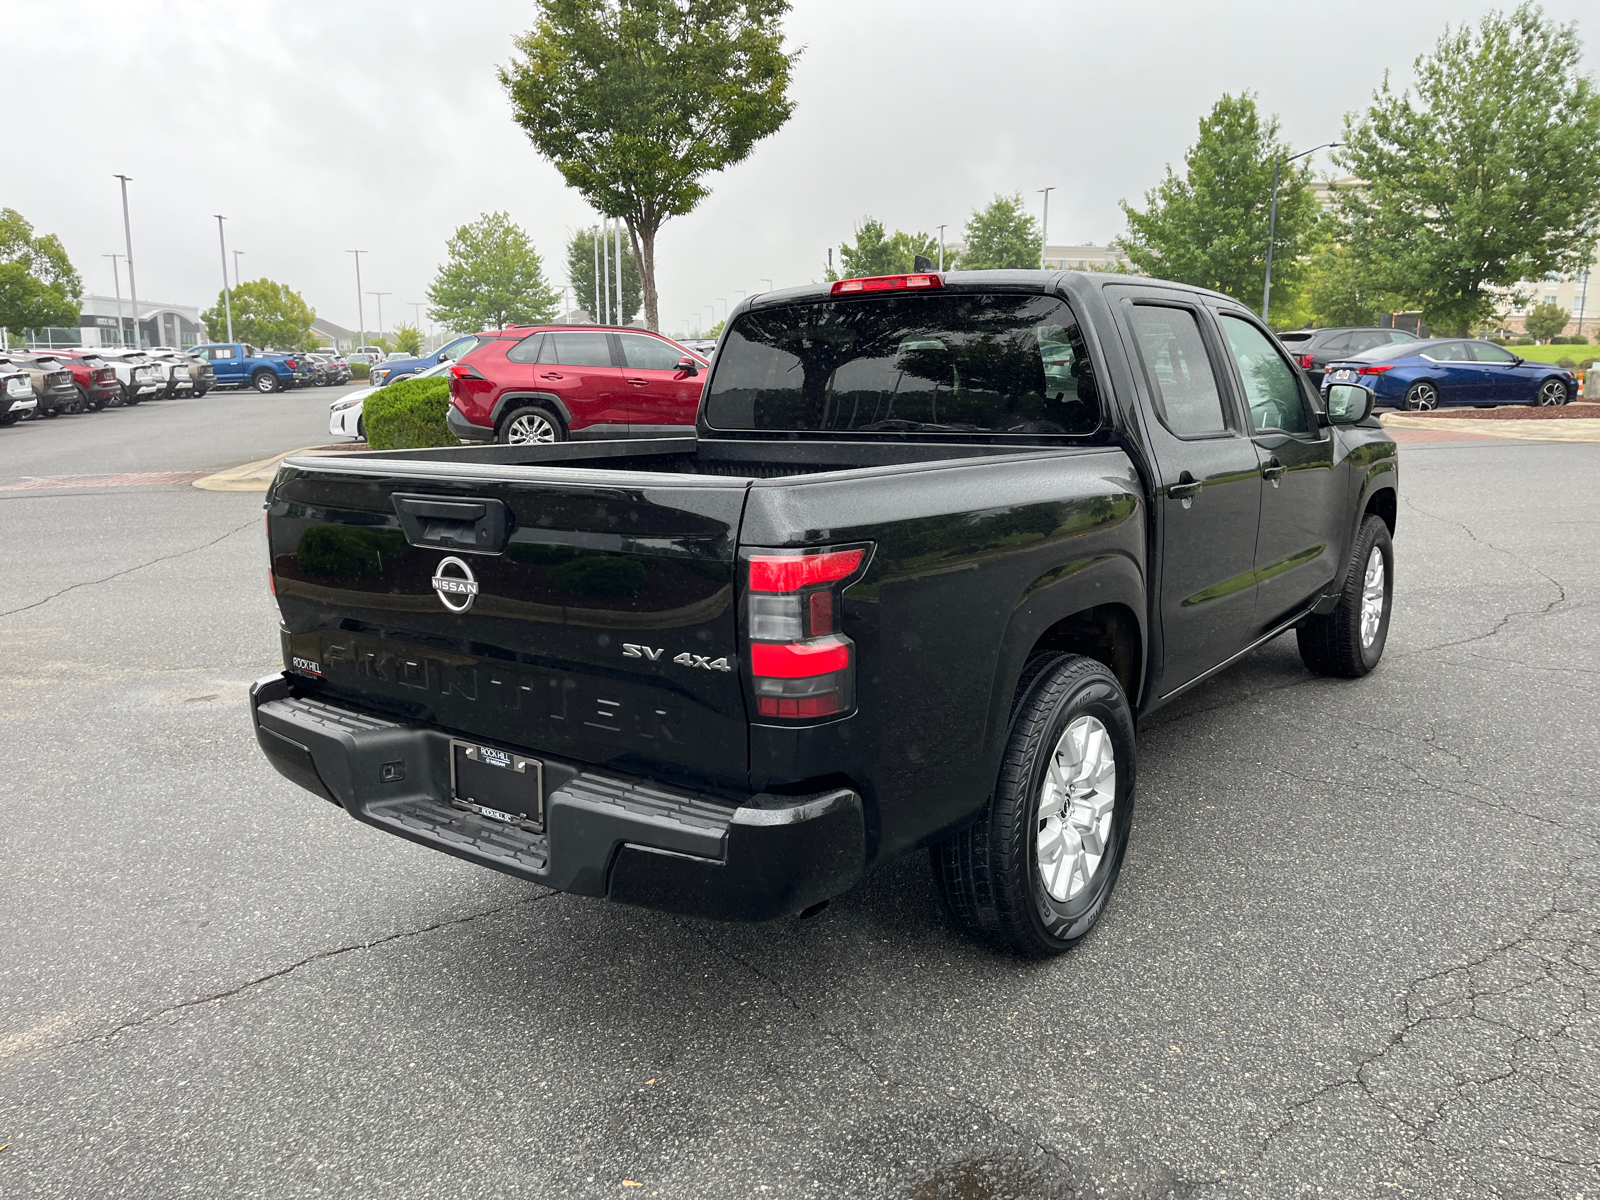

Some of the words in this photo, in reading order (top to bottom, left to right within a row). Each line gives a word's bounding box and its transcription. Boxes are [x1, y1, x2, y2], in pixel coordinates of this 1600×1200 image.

[432, 578, 477, 594] NISSAN
[622, 643, 665, 662] SV
[293, 656, 309, 670] ROCK
[309, 660, 322, 674] HILL
[480, 747, 498, 758] ROCK
[497, 751, 510, 762] HILL
